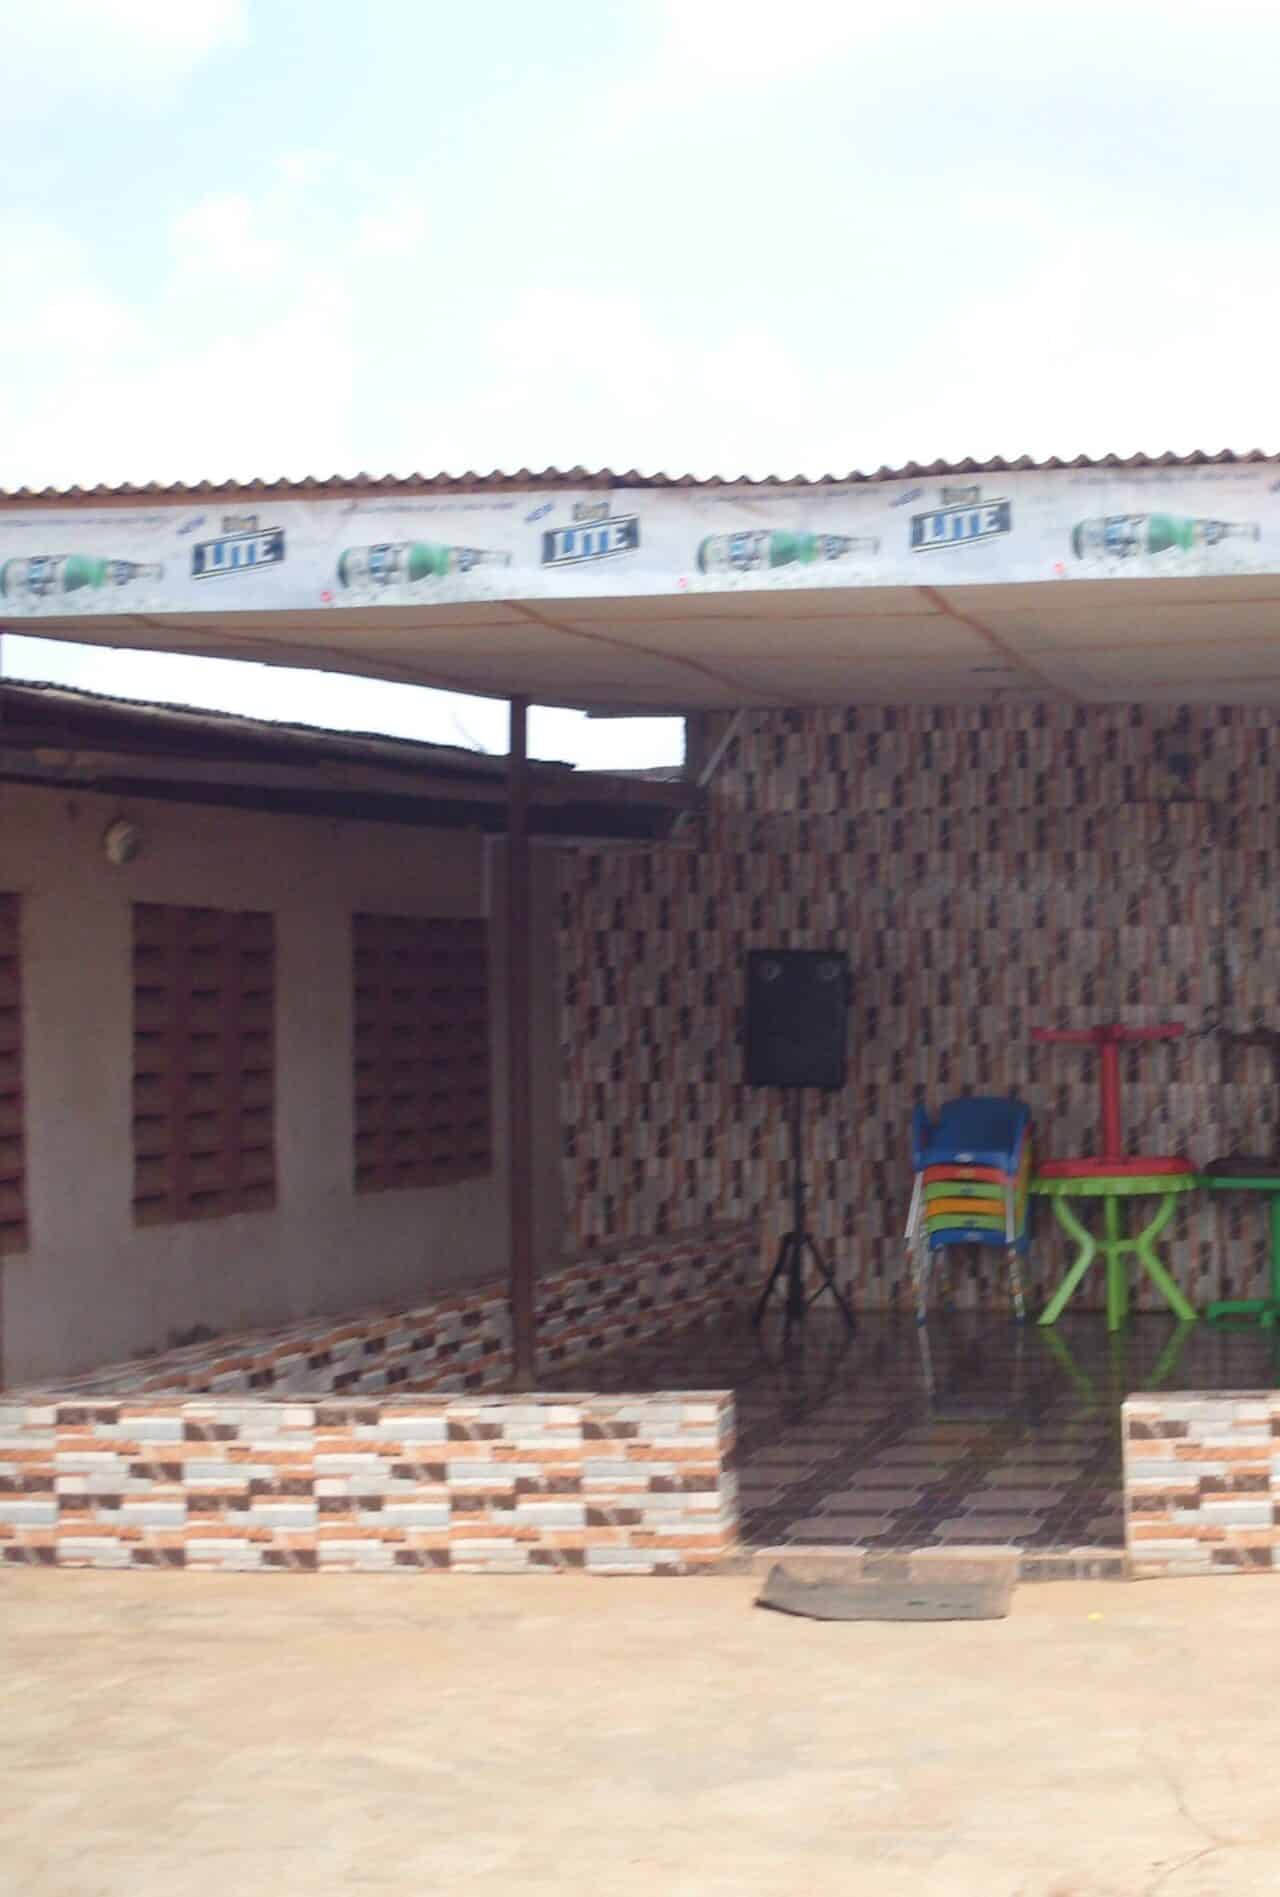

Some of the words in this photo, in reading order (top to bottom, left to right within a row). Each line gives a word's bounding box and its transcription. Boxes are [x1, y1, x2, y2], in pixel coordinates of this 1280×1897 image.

[553, 522, 629, 560] LITE
[923, 507, 1000, 544] LITE
[203, 536, 276, 571] LITE
